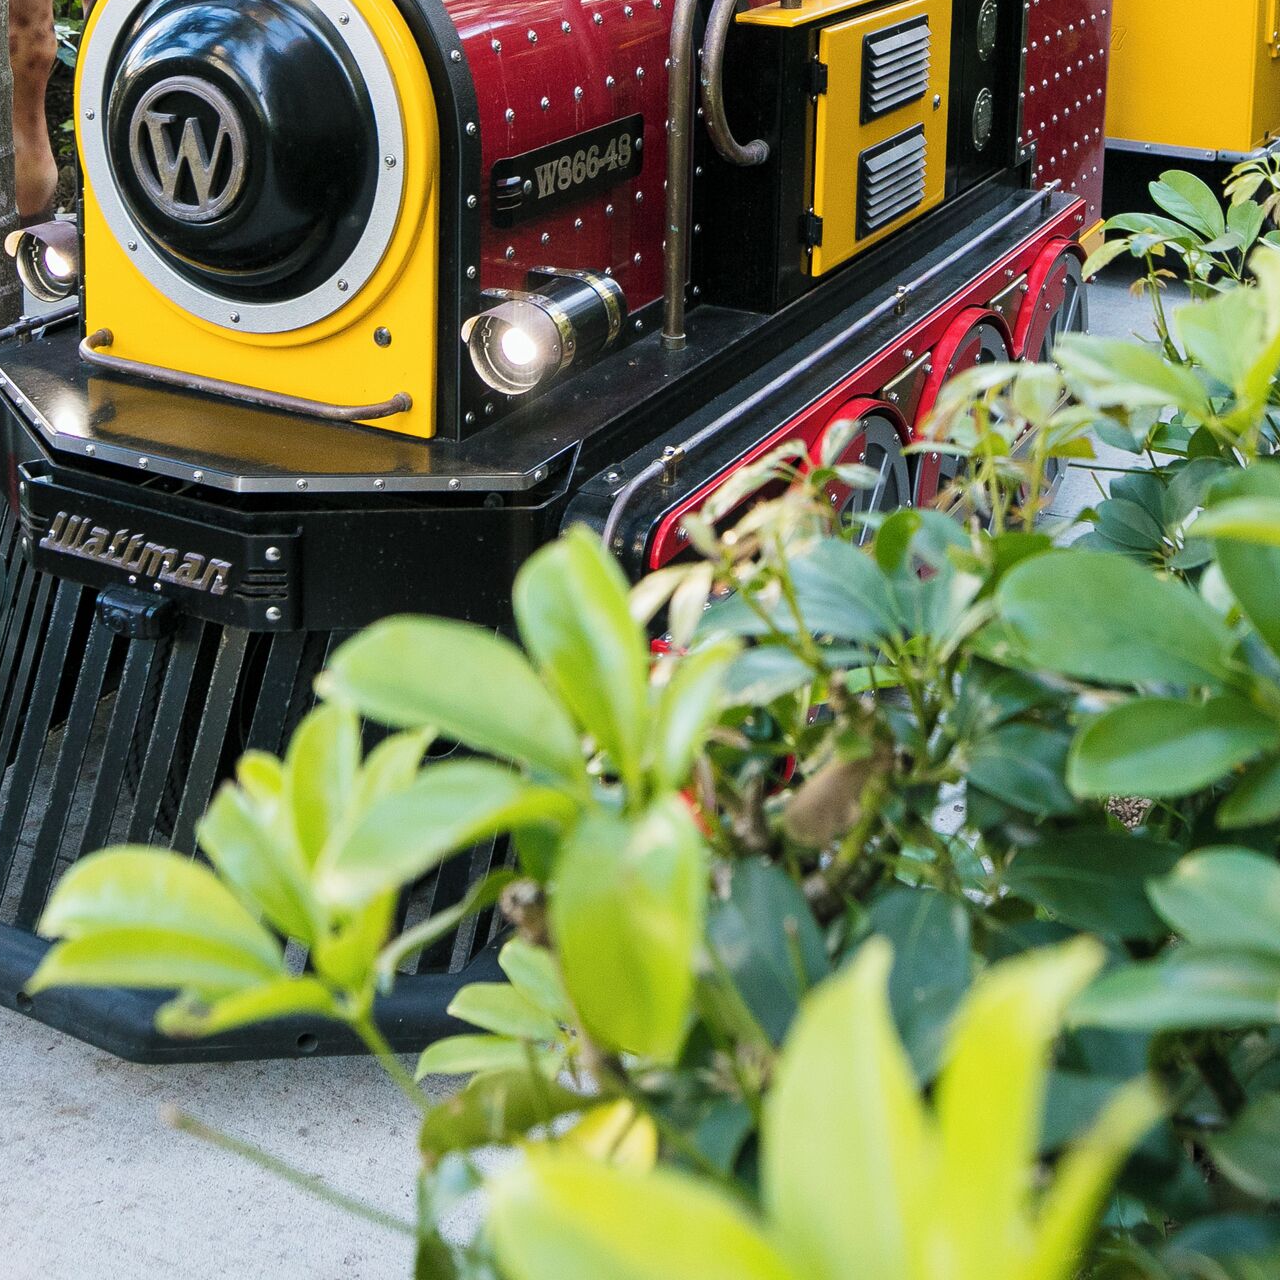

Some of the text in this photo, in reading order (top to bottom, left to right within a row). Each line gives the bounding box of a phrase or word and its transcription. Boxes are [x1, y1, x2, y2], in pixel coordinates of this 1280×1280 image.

[139, 104, 235, 211] W
[534, 133, 632, 200] W866-48
[39, 511, 233, 595] Wattman
